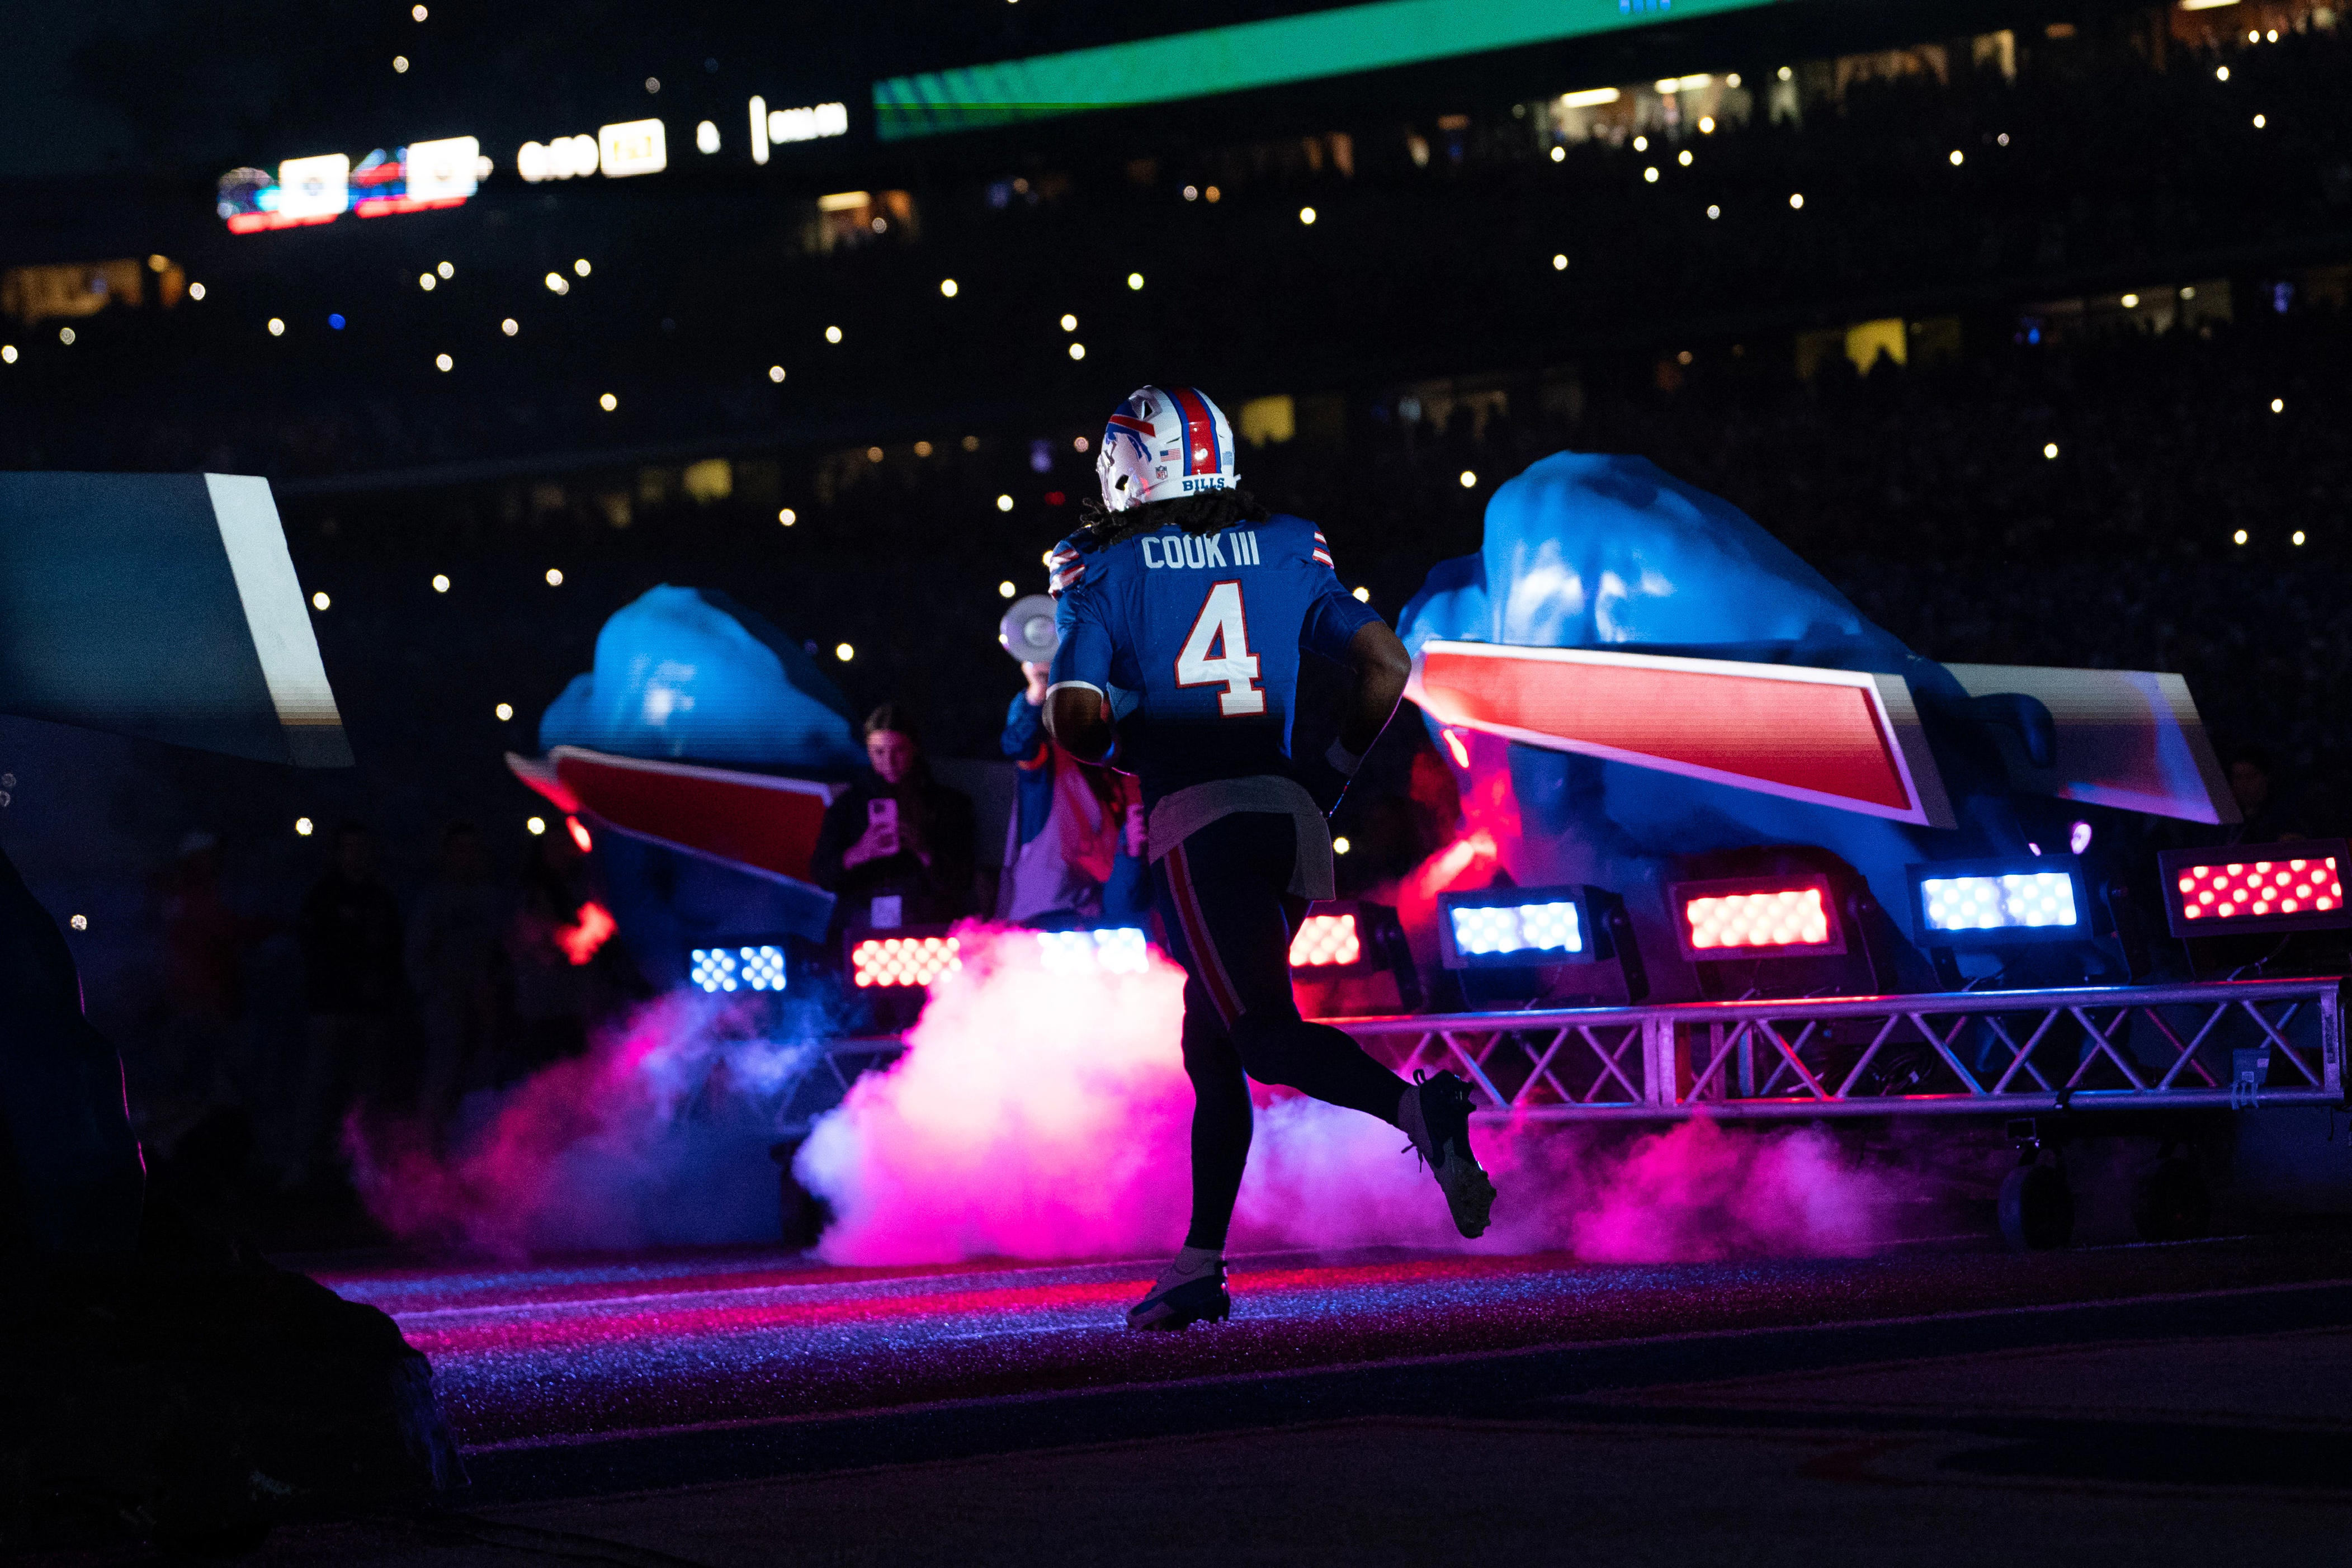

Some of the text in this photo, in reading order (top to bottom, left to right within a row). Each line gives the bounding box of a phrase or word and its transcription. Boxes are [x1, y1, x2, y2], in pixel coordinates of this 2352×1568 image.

[1182, 478, 1225, 491] BILLS
[1141, 531, 1260, 569] COOK III
[1174, 579, 1267, 719] 4
